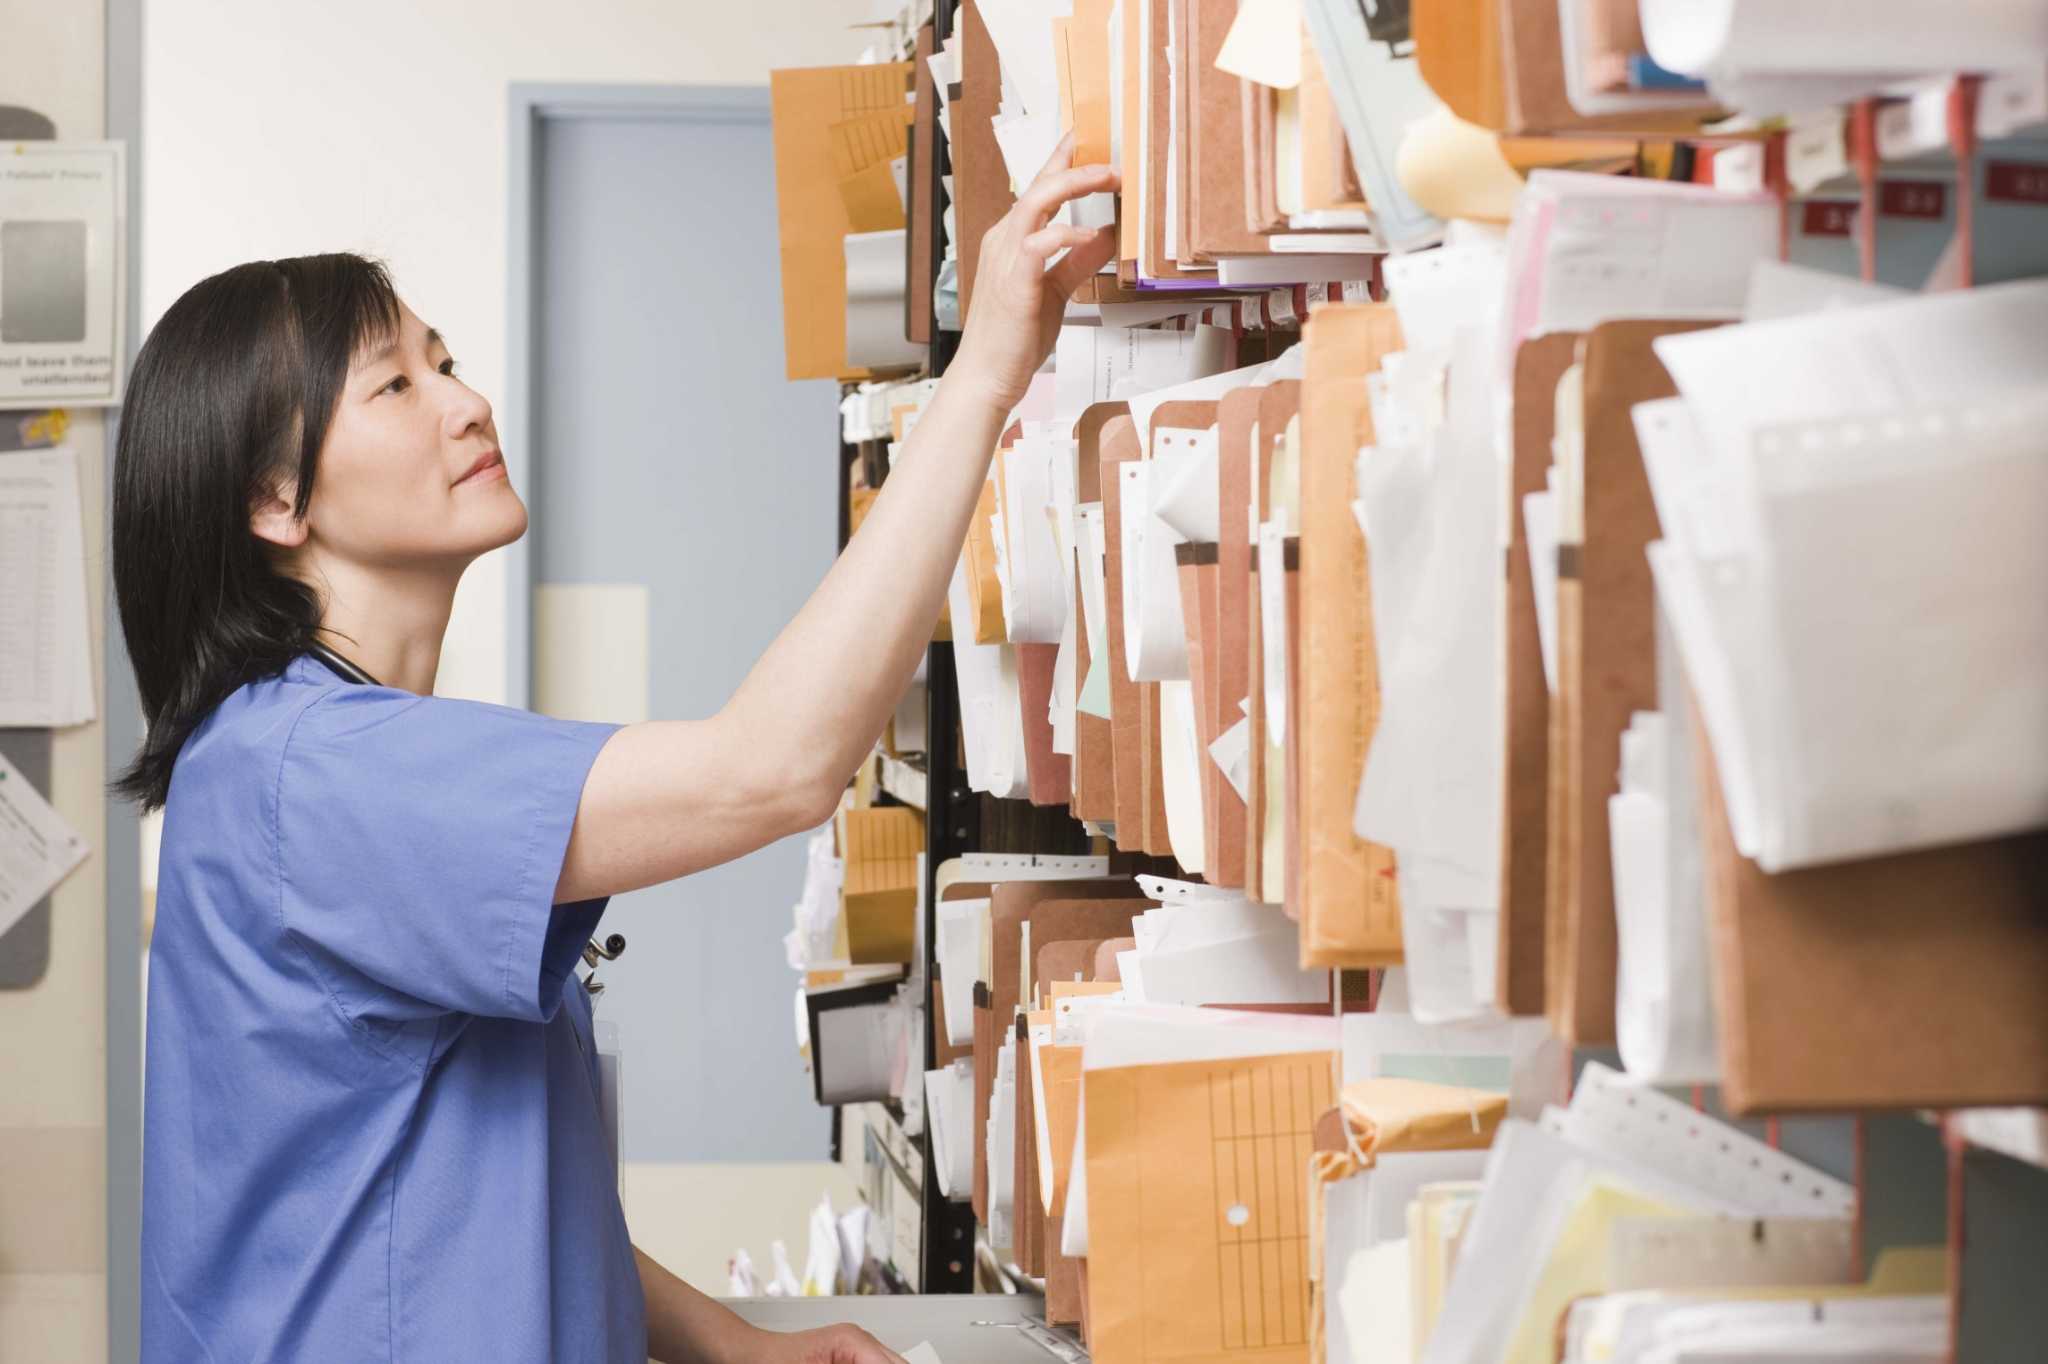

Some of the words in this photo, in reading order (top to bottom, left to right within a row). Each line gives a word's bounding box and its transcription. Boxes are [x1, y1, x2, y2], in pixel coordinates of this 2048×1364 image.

[26, 355, 65, 367] leave
[71, 354, 110, 366] them
[22, 372, 110, 386] unattended
